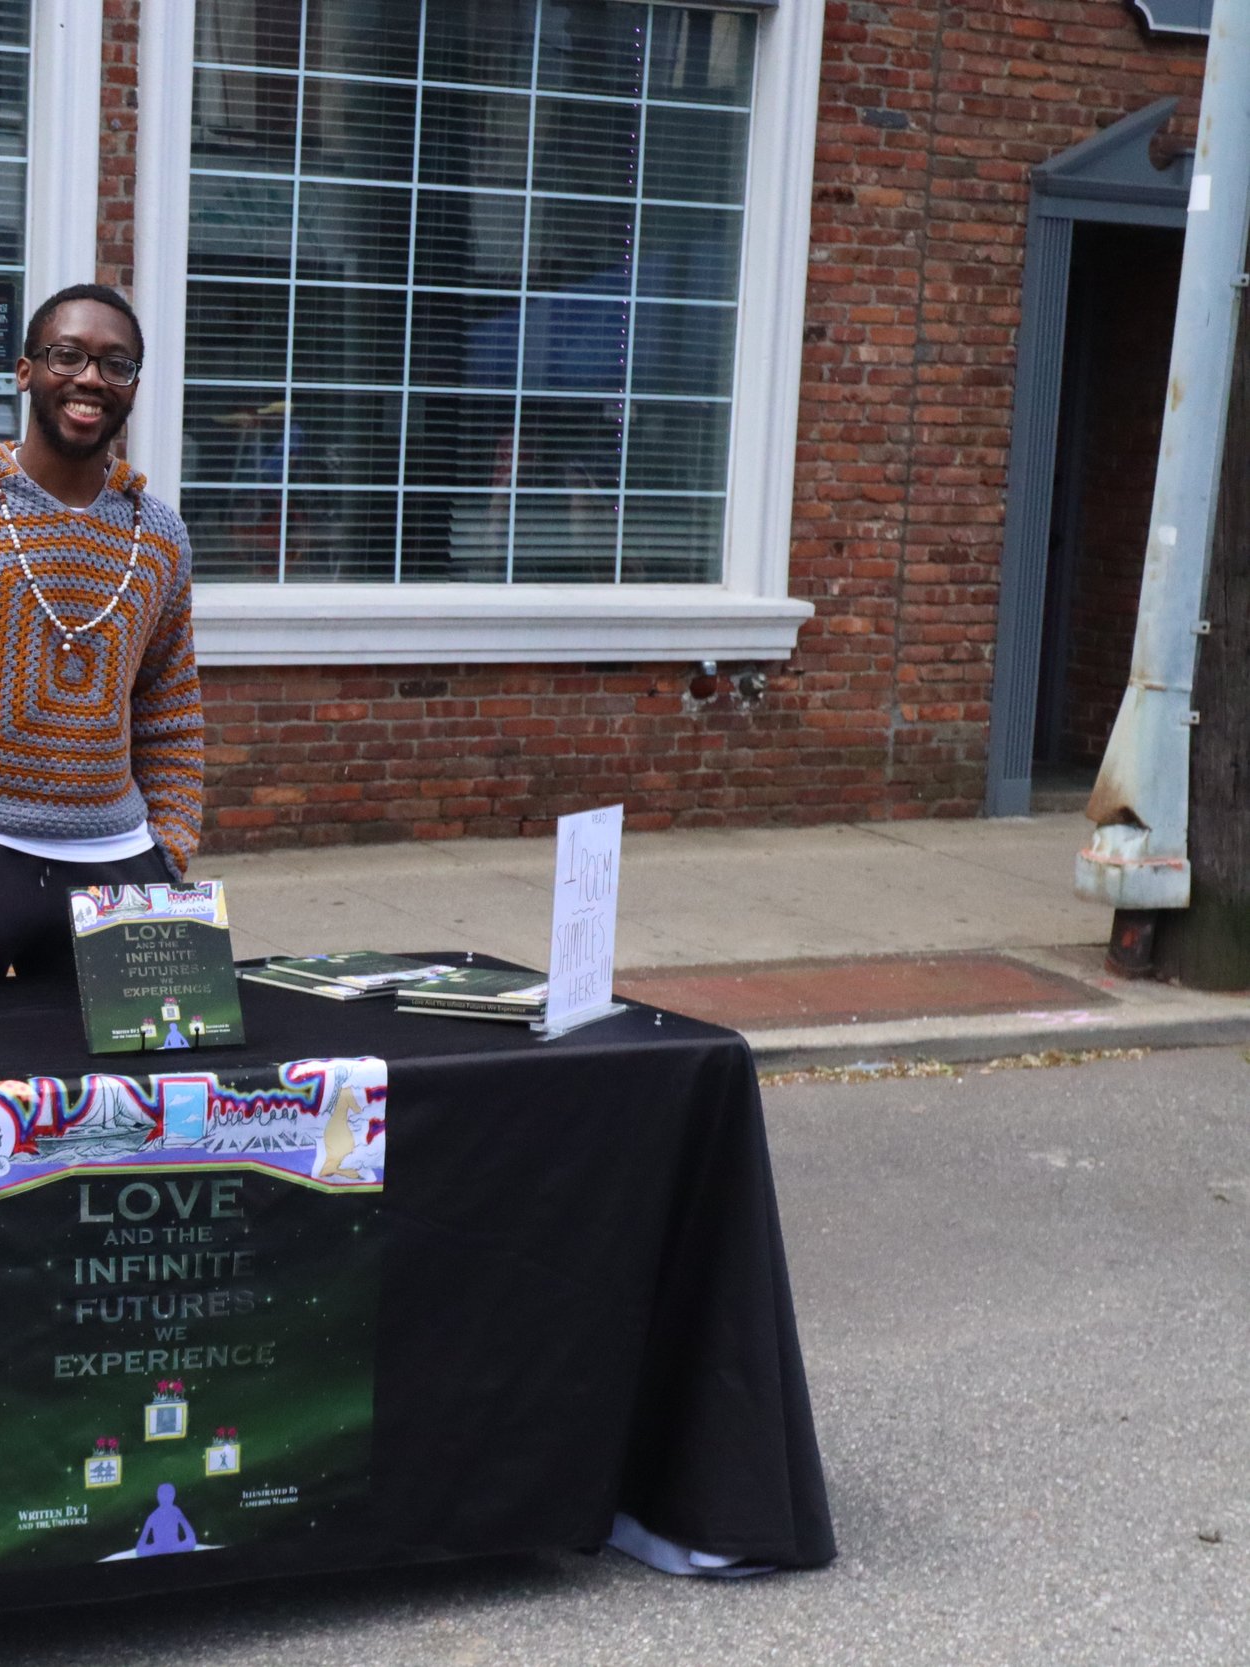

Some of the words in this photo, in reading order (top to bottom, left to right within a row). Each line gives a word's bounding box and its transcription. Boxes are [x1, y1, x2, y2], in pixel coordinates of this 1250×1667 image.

[563, 829, 577, 885] 1
[579, 847, 613, 903] POEM
[124, 923, 190, 941] LOVE
[135, 941, 156, 950] AND
[552, 911, 606, 980] SAMPLES
[125, 949, 198, 964] INFINITE
[128, 963, 200, 978] FUTURES
[123, 984, 212, 998] EXPERIENCE
[78, 1178, 245, 1224] LOVE
[103, 1229, 154, 1246] AND
[162, 1226, 214, 1244] THE
[75, 1250, 257, 1285] INFINITE
[75, 1290, 255, 1325] FUTURES
[154, 1326, 187, 1342] WE
[54, 1341, 276, 1379] EXPERIENCE
